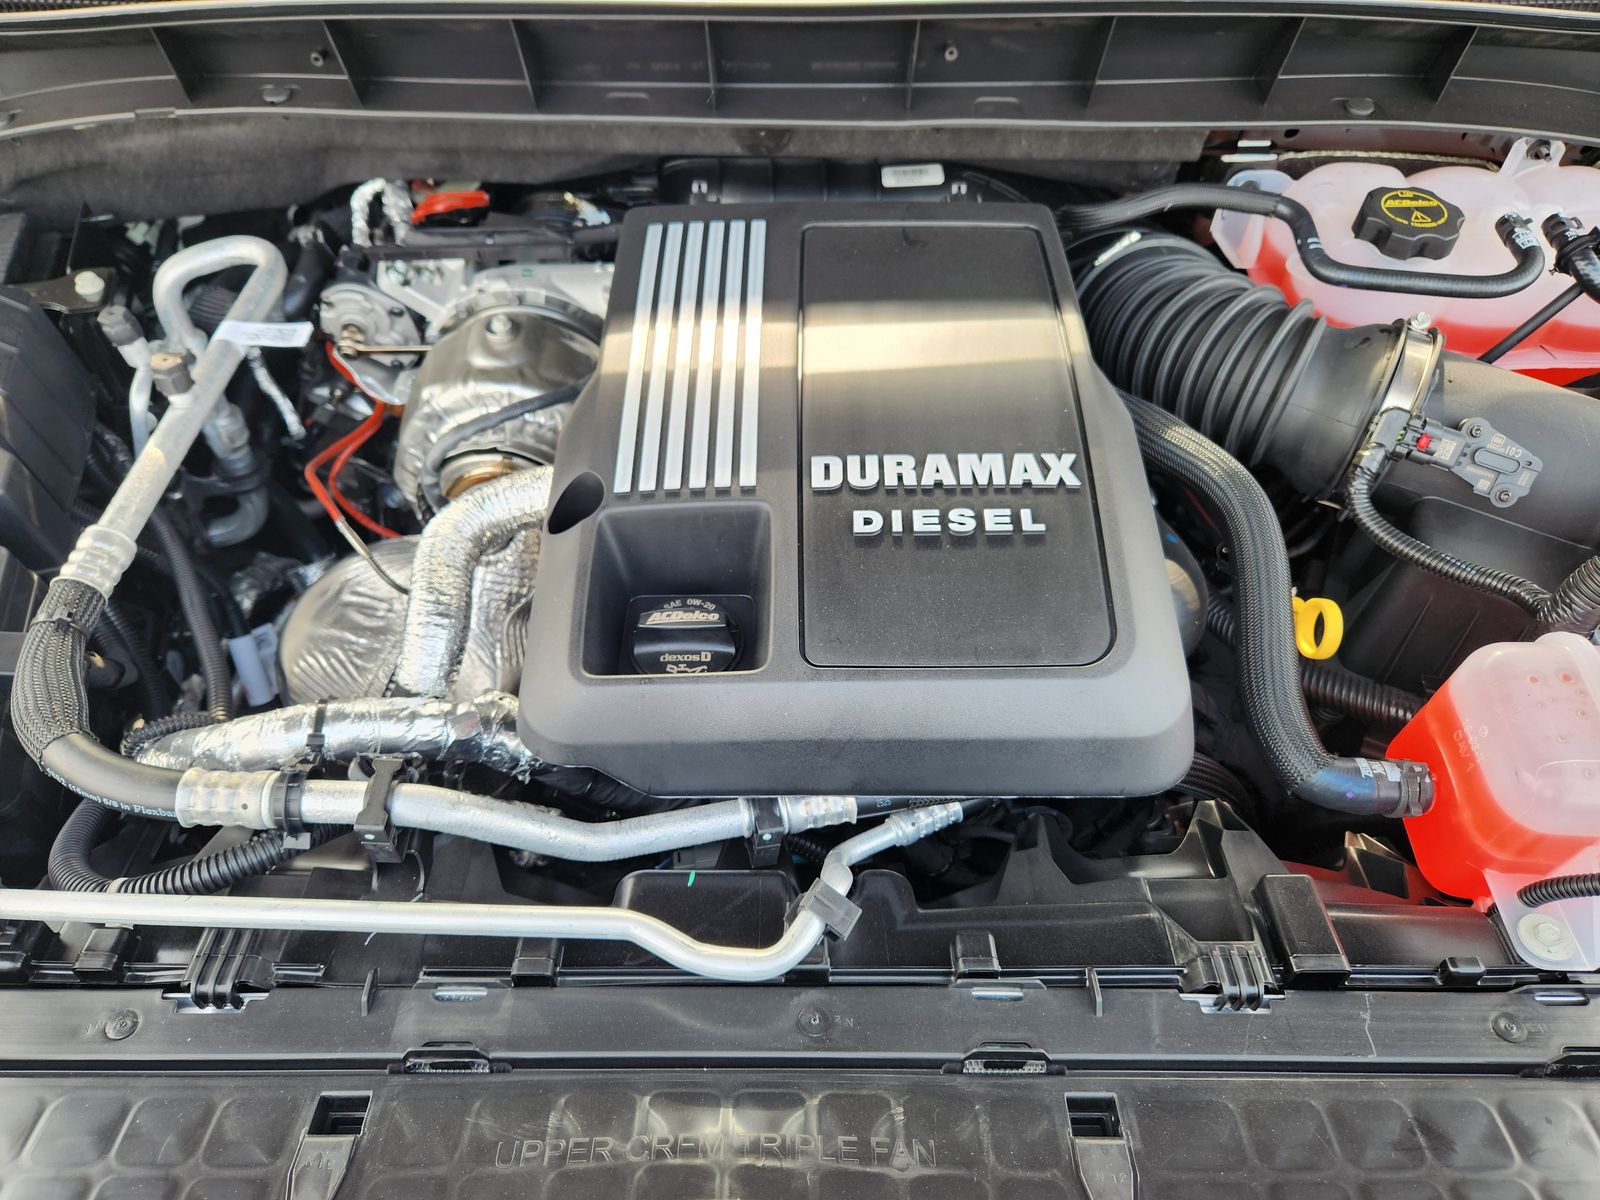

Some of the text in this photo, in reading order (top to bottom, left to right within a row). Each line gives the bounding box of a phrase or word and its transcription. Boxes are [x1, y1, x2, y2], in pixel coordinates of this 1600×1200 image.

[811, 453, 1082, 490] DURAMAX
[853, 508, 1047, 536] DIESEL
[645, 610, 721, 625] ACDelco
[663, 598, 716, 611] SAE 0W-20
[495, 1135, 614, 1169] UPPER
[736, 1133, 860, 1164] TRIPLE
[870, 1136, 937, 1168] FAN
